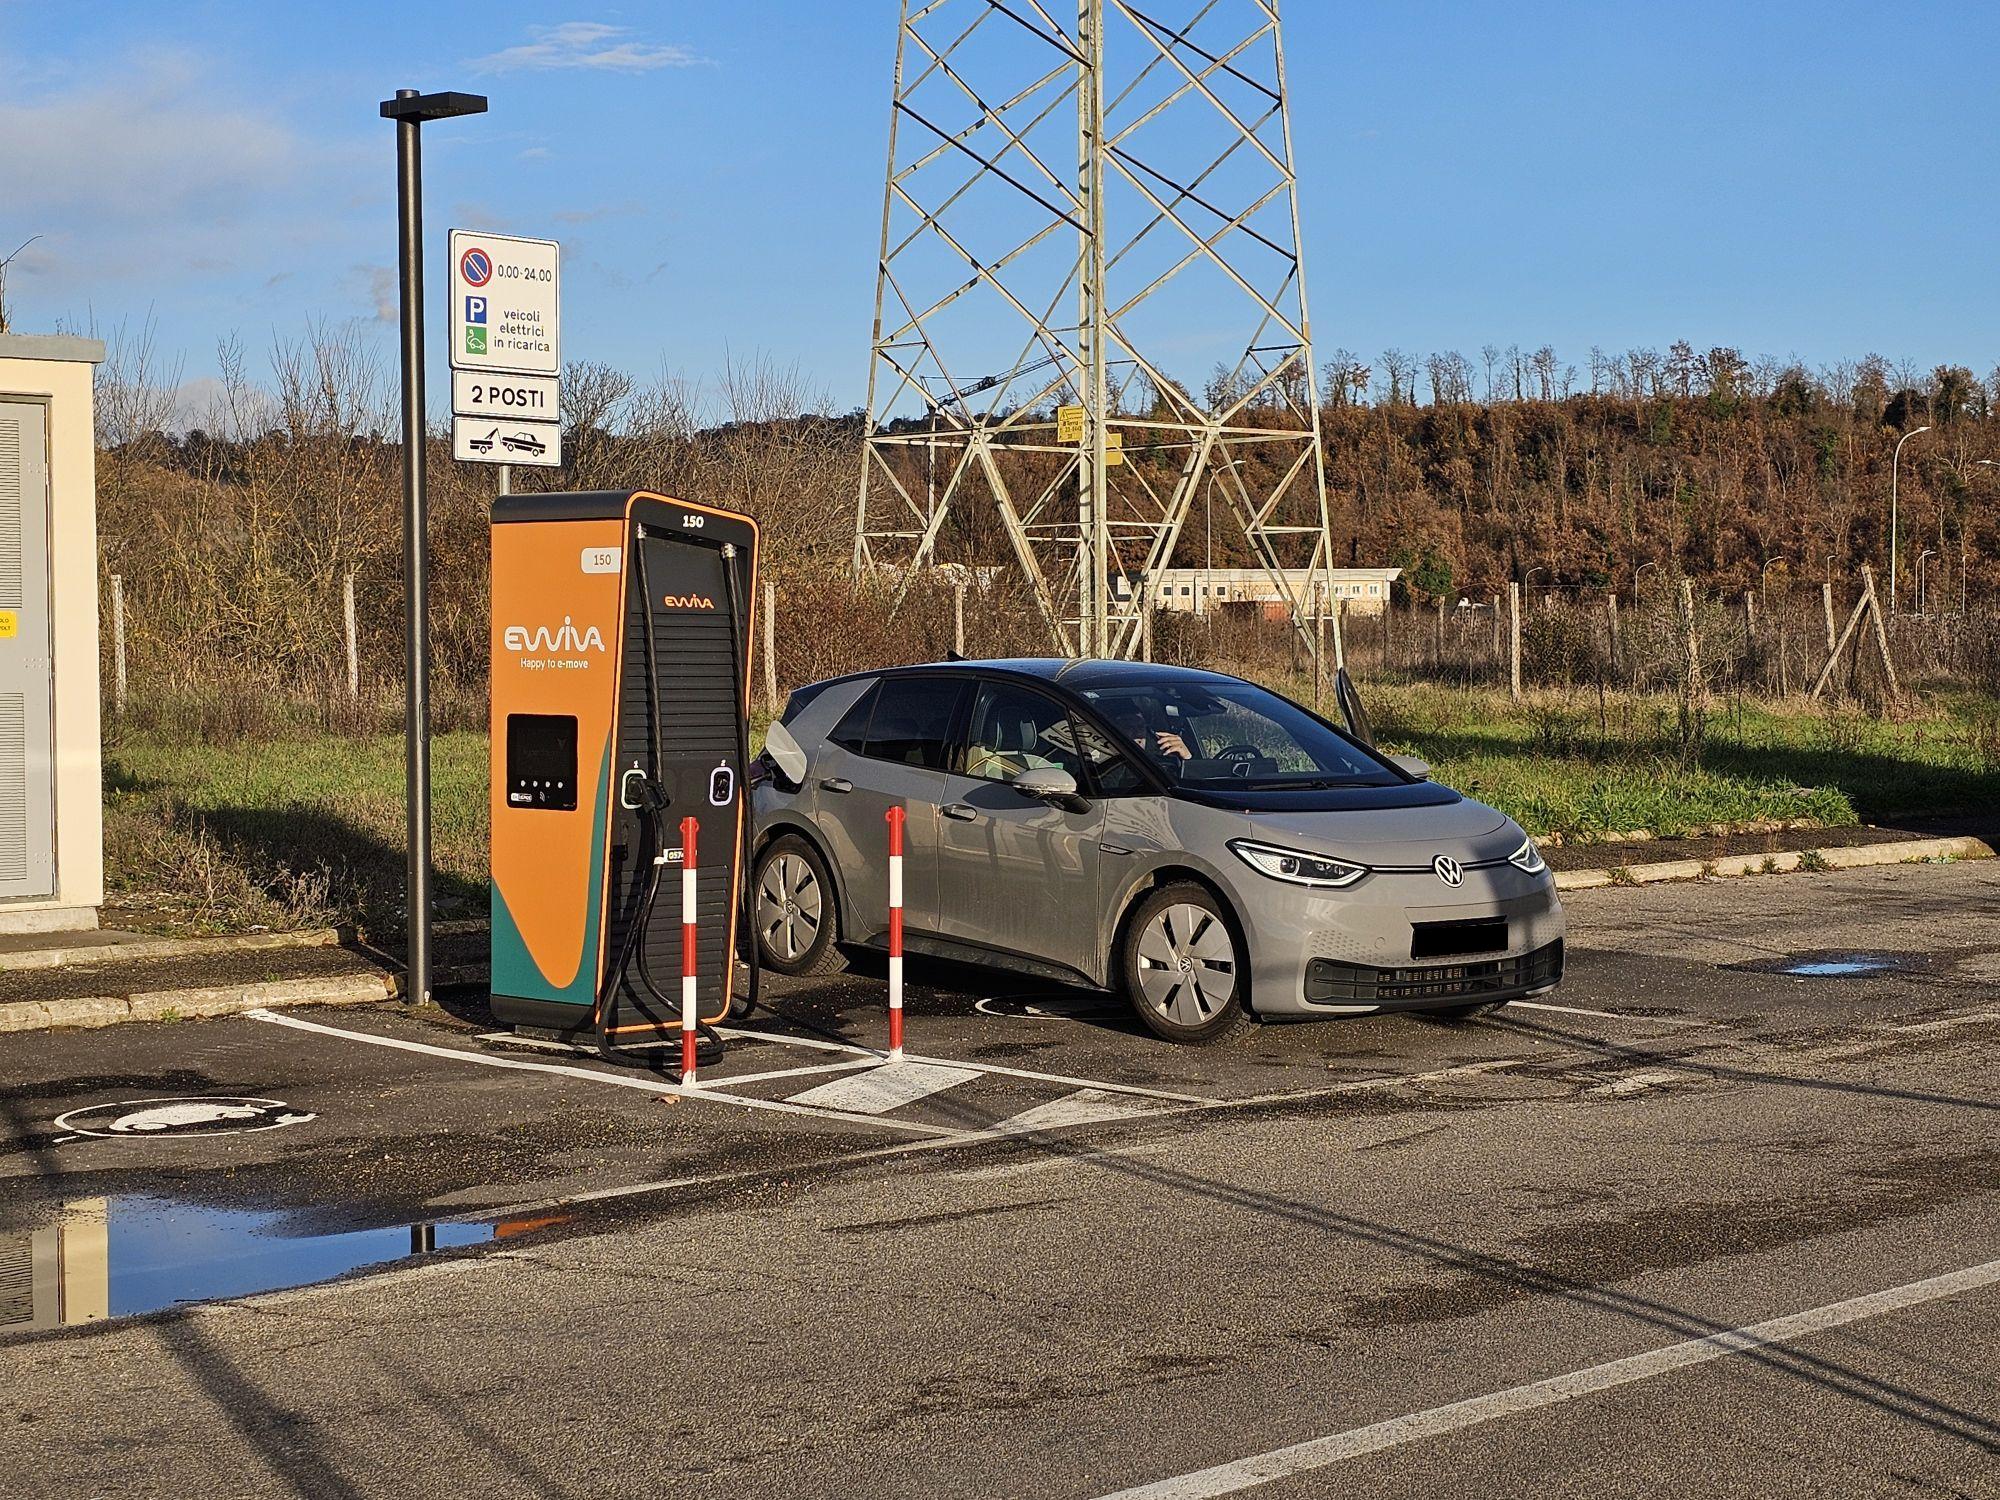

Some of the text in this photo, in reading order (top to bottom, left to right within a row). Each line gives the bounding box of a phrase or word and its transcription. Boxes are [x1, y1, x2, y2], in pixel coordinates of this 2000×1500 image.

[470, 299, 485, 321] P
[503, 309, 540, 323] veicoli
[499, 324, 545, 338] elettrici
[494, 336, 550, 352] in ricarica
[471, 385, 544, 408] 2 POSTI
[682, 515, 705, 528] 150
[593, 554, 612, 566] 150
[520, 658, 589, 670] Happy to e-move
[1436, 857, 1463, 887] VW
